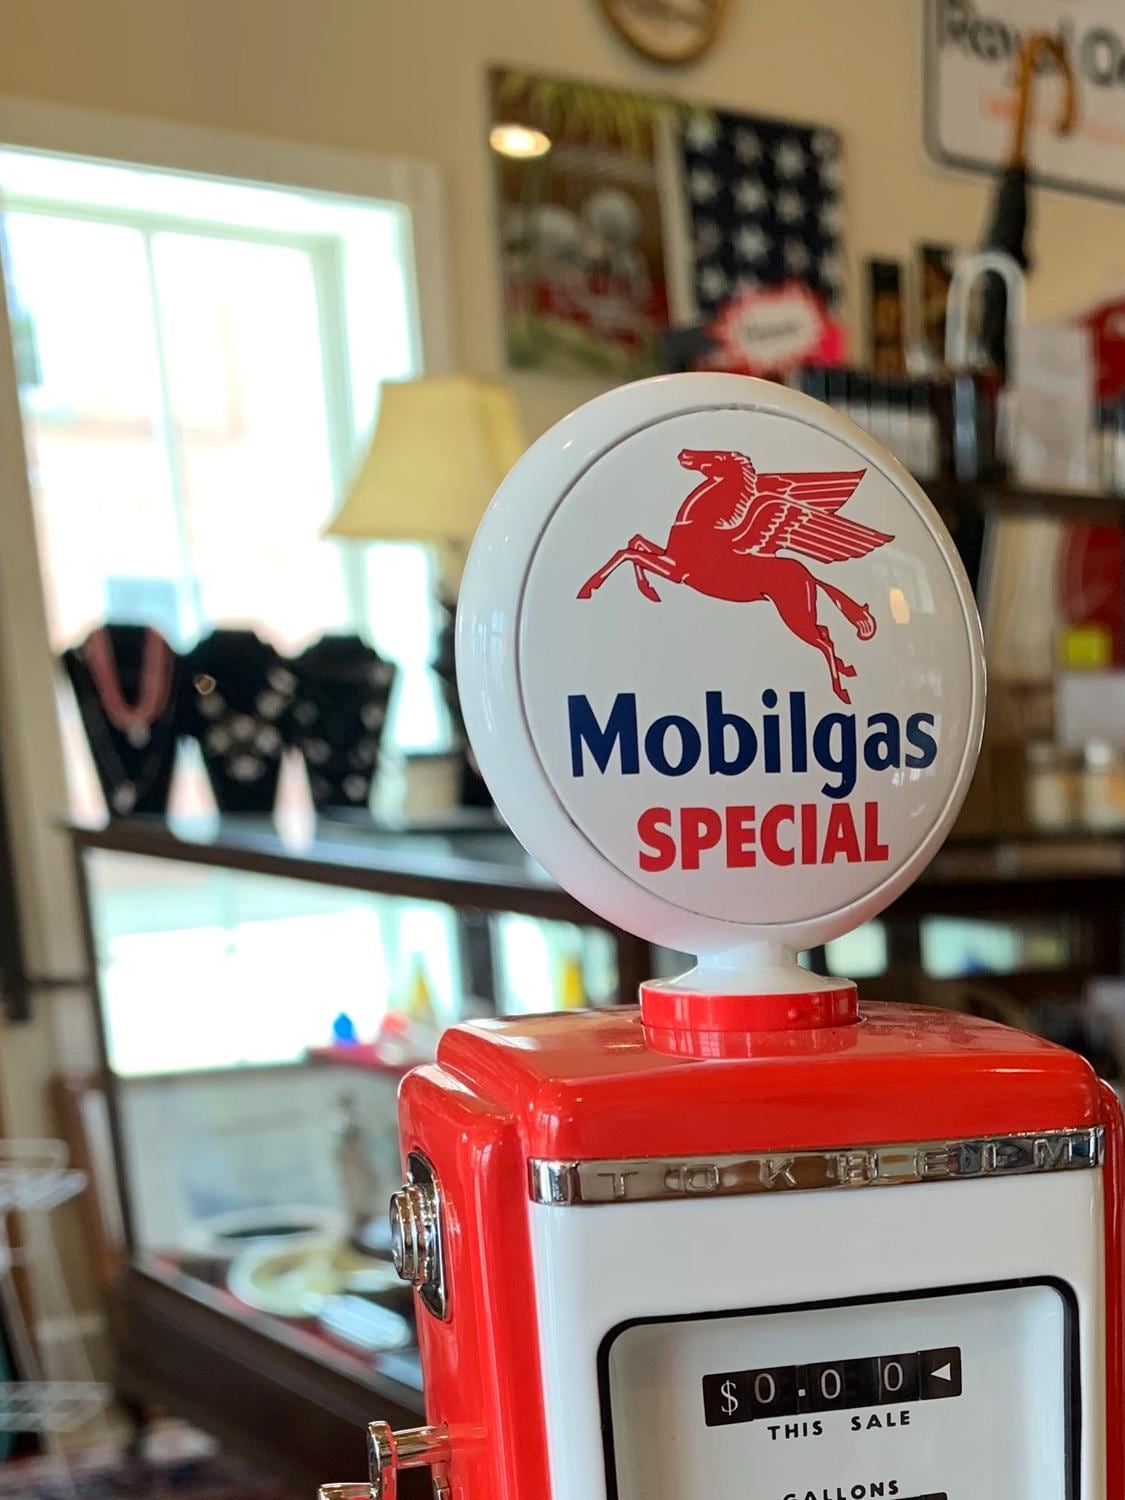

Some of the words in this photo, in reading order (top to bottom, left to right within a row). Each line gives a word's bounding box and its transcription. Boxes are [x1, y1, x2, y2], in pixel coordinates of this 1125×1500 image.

[567, 688, 938, 799] Mobilgas
[636, 801, 889, 873] SPECIAL
[767, 1420, 823, 1440] THIS
[851, 1410, 911, 1431] SALE
